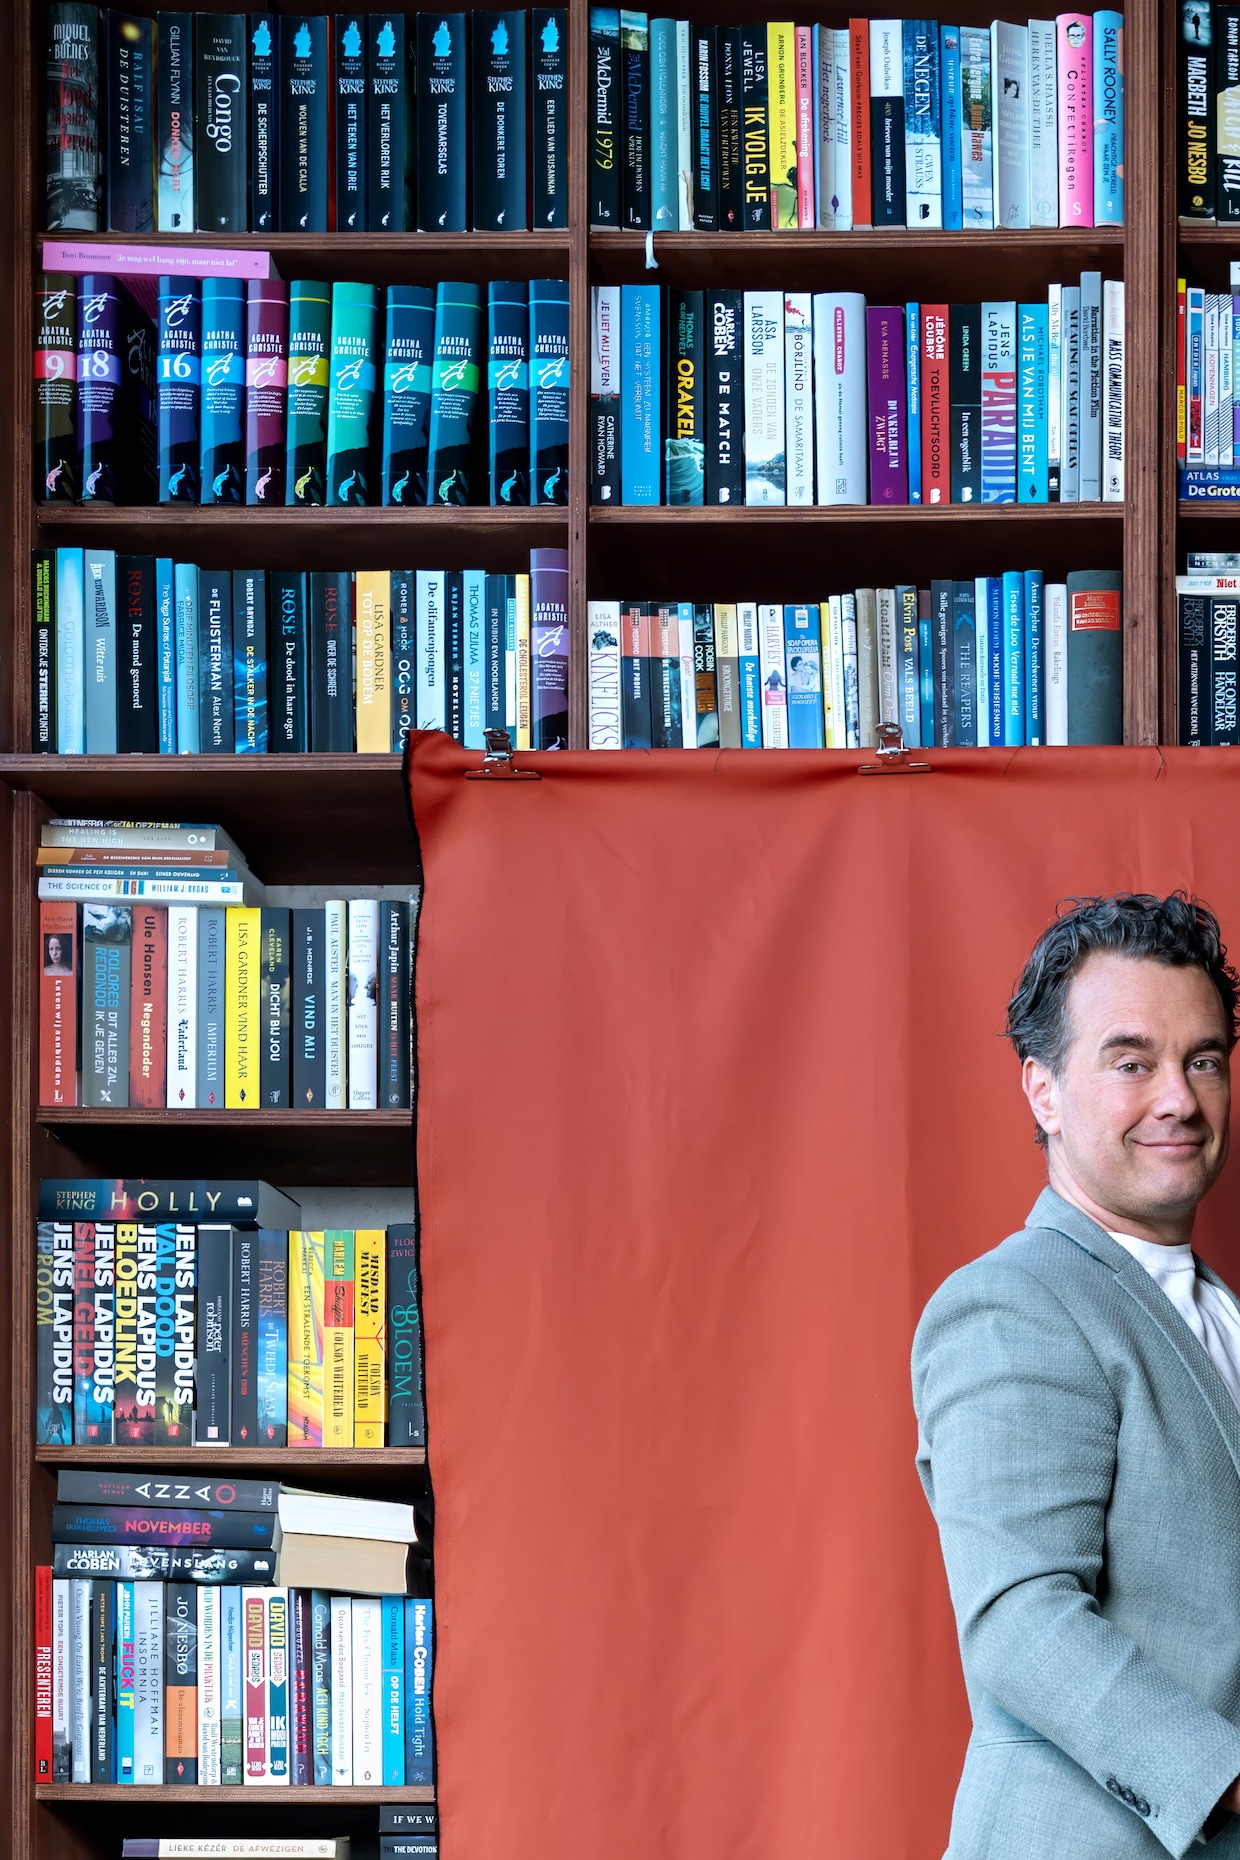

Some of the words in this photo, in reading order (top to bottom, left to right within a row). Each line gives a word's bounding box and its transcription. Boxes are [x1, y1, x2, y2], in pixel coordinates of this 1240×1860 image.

[170, 25, 180, 67] GILLIAN
[915, 36, 927, 52] DE
[1103, 28, 1116, 63] SALLY
[170, 71, 180, 105] FLYNN
[914, 56, 930, 116] NEGEN
[1103, 69, 1116, 123] ROONEY
[1188, 56, 1207, 116] MACBETH
[206, 73, 240, 153] Congo
[258, 103, 267, 114] DE
[745, 107, 767, 124] IK
[437, 103, 447, 175] TOVENAARSGLAS
[1188, 121, 1207, 137] JO
[258, 118, 267, 195] SCHERPSCHUTTER
[596, 129, 613, 170] 1979
[745, 128, 767, 175] VOLG
[745, 181, 767, 203] JE
[164, 330, 193, 339] AGATHA
[714, 303, 727, 357] COBEN
[925, 316, 935, 360] LOUBRY
[161, 339, 196, 350] CHRISTIE
[45, 356, 64, 380] 9
[82, 350, 110, 377] 18
[162, 350, 192, 378] 16
[719, 372, 730, 395] DE
[677, 359, 695, 438] ORAKEL
[718, 398, 730, 464] MATCH
[930, 370, 940, 478] TOEVLUCHTSOORD
[1186, 471, 1219, 481] ATLAS
[212, 588, 218, 598] DE
[428, 582, 438, 599] De
[210, 600, 221, 691] FLUISTERMAN
[425, 600, 439, 687] olifantenjongen
[960, 643, 970, 669] THE
[904, 658, 914, 684] VALS
[212, 696, 221, 716] Alex
[590, 653, 618, 745] KINFLICKS
[905, 687, 914, 723] BEELD
[960, 674, 971, 728] REAPERS
[212, 720, 221, 746] North
[144, 915, 155, 937] Ule
[144, 944, 155, 996] Hansen
[270, 983, 280, 1017] DICHT
[305, 995, 315, 1030] VIND
[270, 1019, 280, 1034] BIJ
[141, 1002, 153, 1079] Negendoder
[270, 1037, 280, 1062] JOU
[305, 1035, 315, 1059] MIJ
[56, 1191, 96, 1200] STEPHEN
[56, 1200, 96, 1210] KING
[111, 1192, 222, 1211] HOLLY
[176, 1222, 195, 1288] JENS
[116, 1224, 137, 1384] BLOEDLINK
[174, 1294, 194, 1404] LAPIDUS
[125, 1520, 211, 1535] NOVEMBER
[66, 1557, 120, 1570] COBEN
[74, 1550, 114, 1559] HARLAN
[130, 1557, 238, 1570] LEVENSLANG
[120, 1641, 135, 1692] FUCK
[391, 1676, 399, 1689] OP
[120, 1694, 135, 1709] IT
[391, 1691, 399, 1703] DE
[391, 1706, 399, 1734] HELFT
